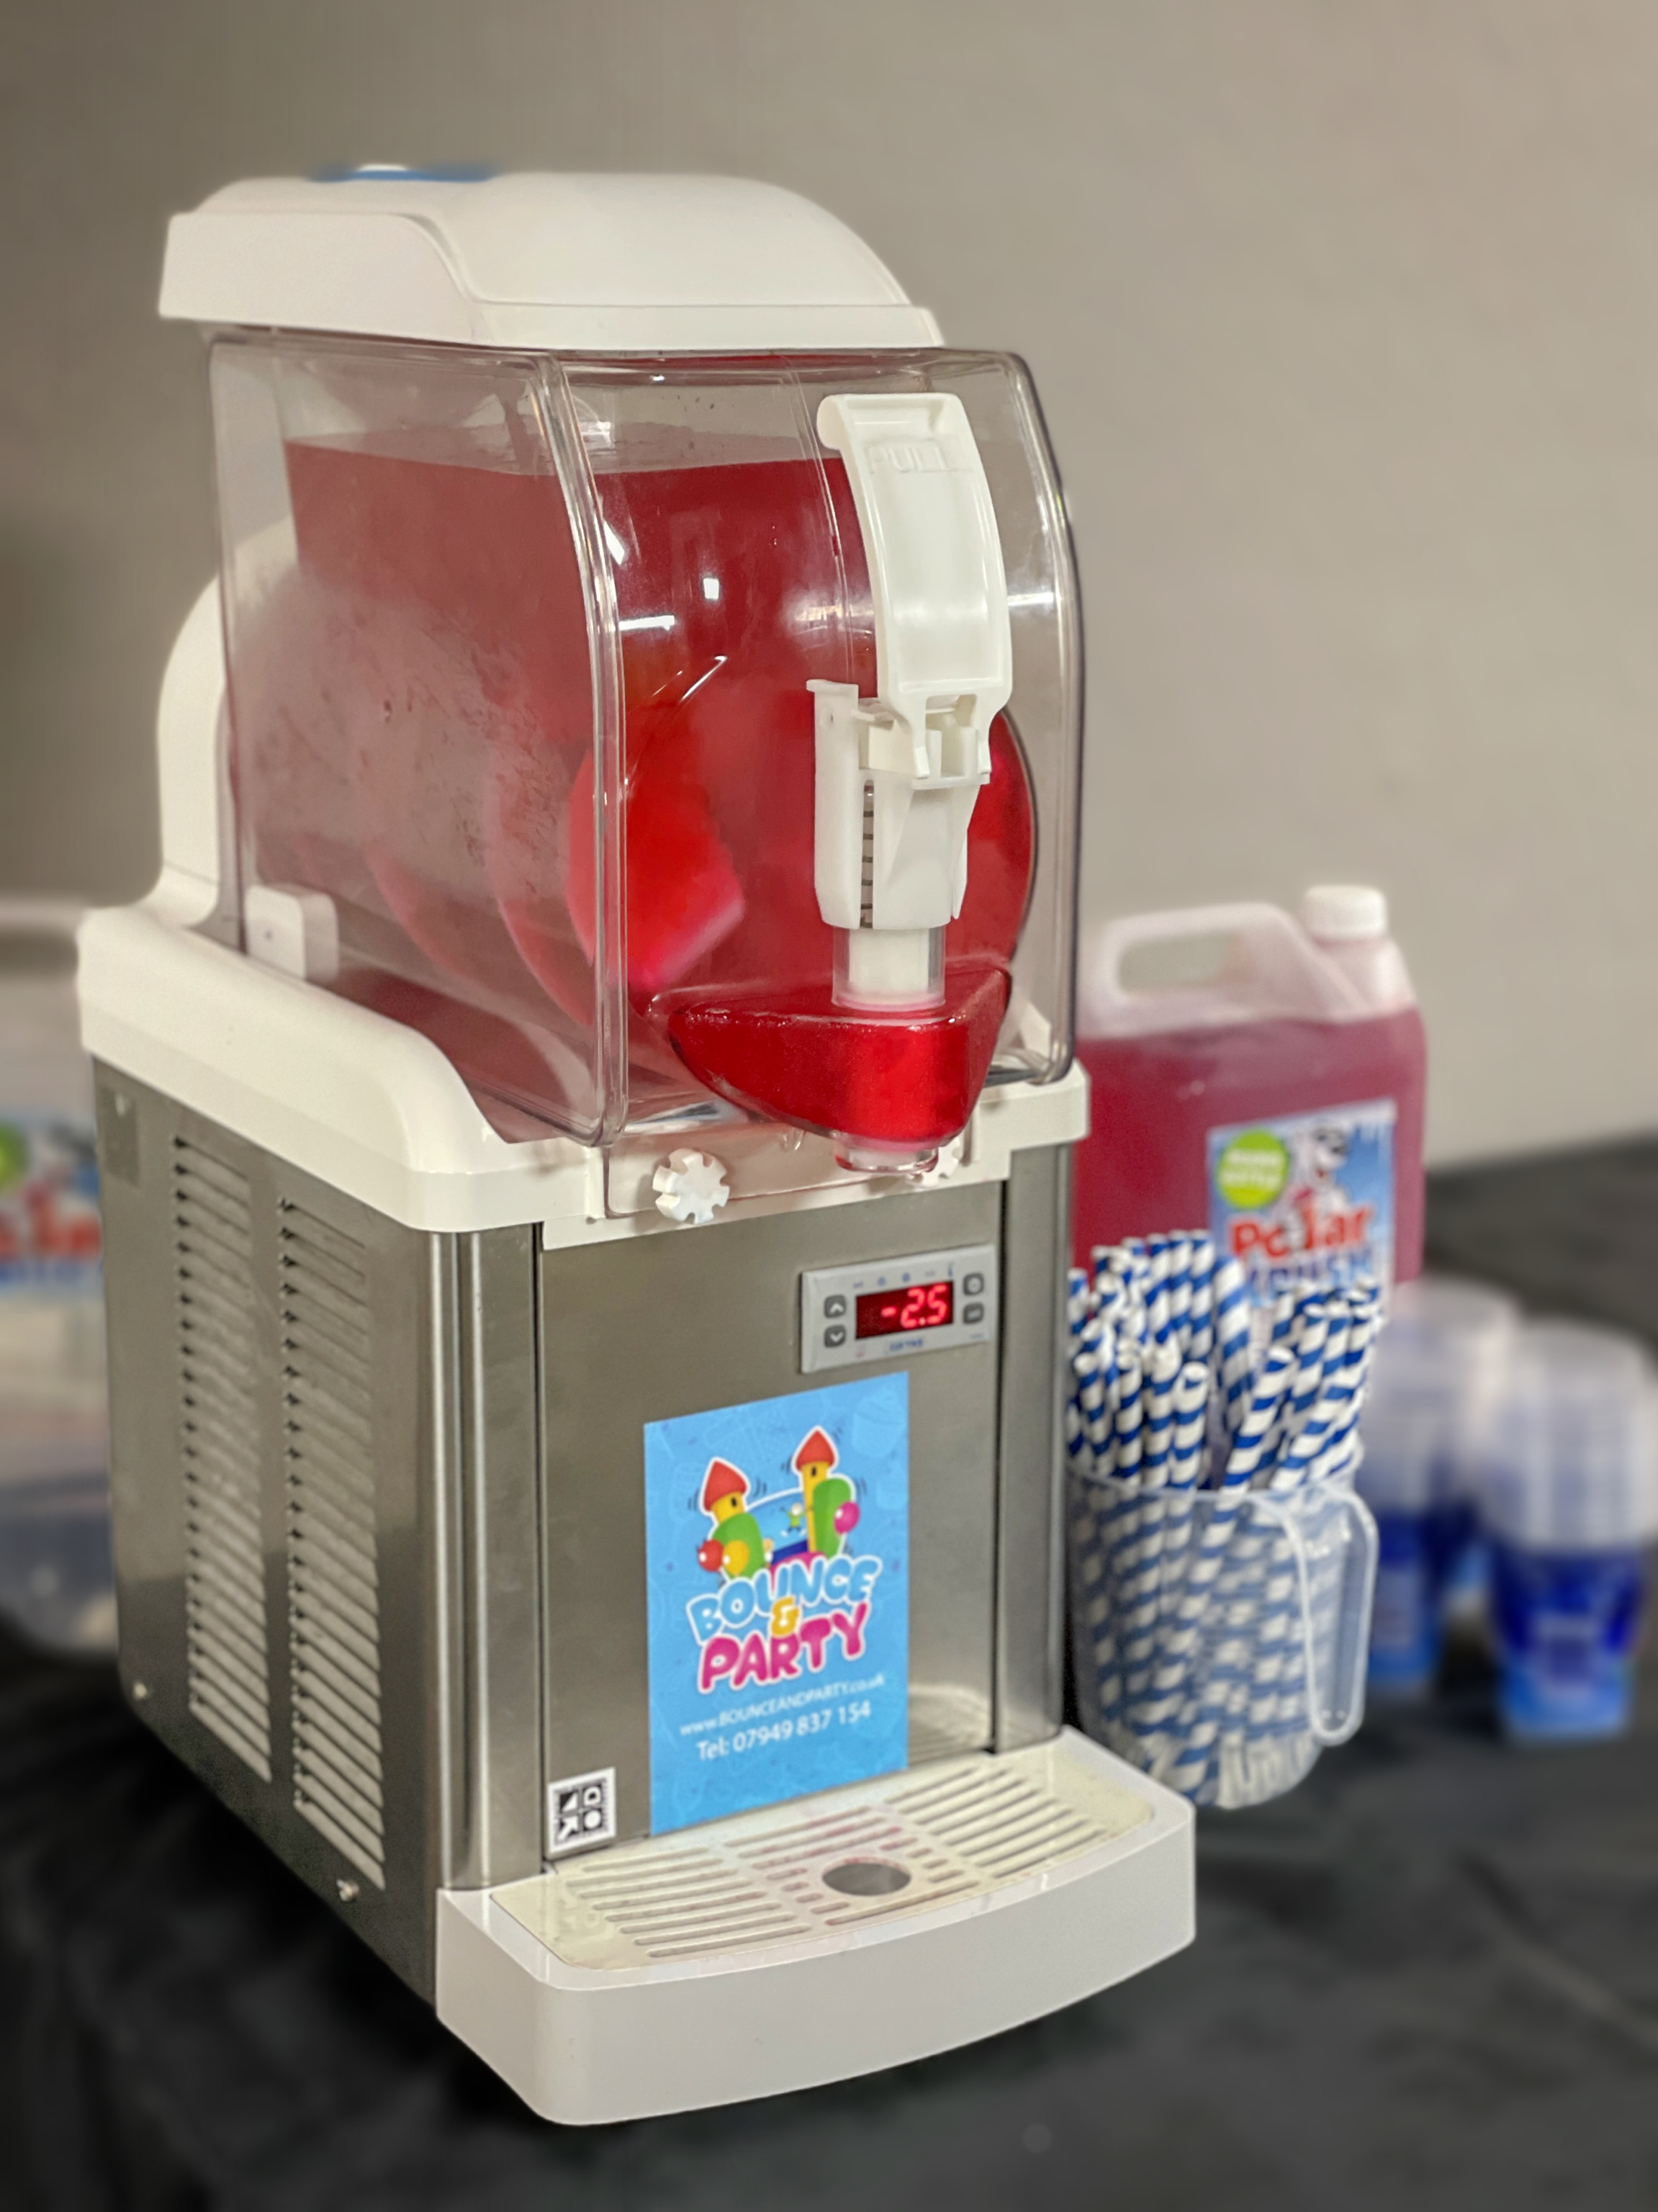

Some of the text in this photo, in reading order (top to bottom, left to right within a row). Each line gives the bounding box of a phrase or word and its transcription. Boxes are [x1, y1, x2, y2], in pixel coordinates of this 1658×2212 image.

[865, 442, 973, 475] PULL
[686, 1553, 883, 1646] BOUNCE
[770, 1595, 801, 1638] &
[697, 1601, 870, 1695] PARTY
[696, 1699, 872, 1761] Tel: 07949 837 154
